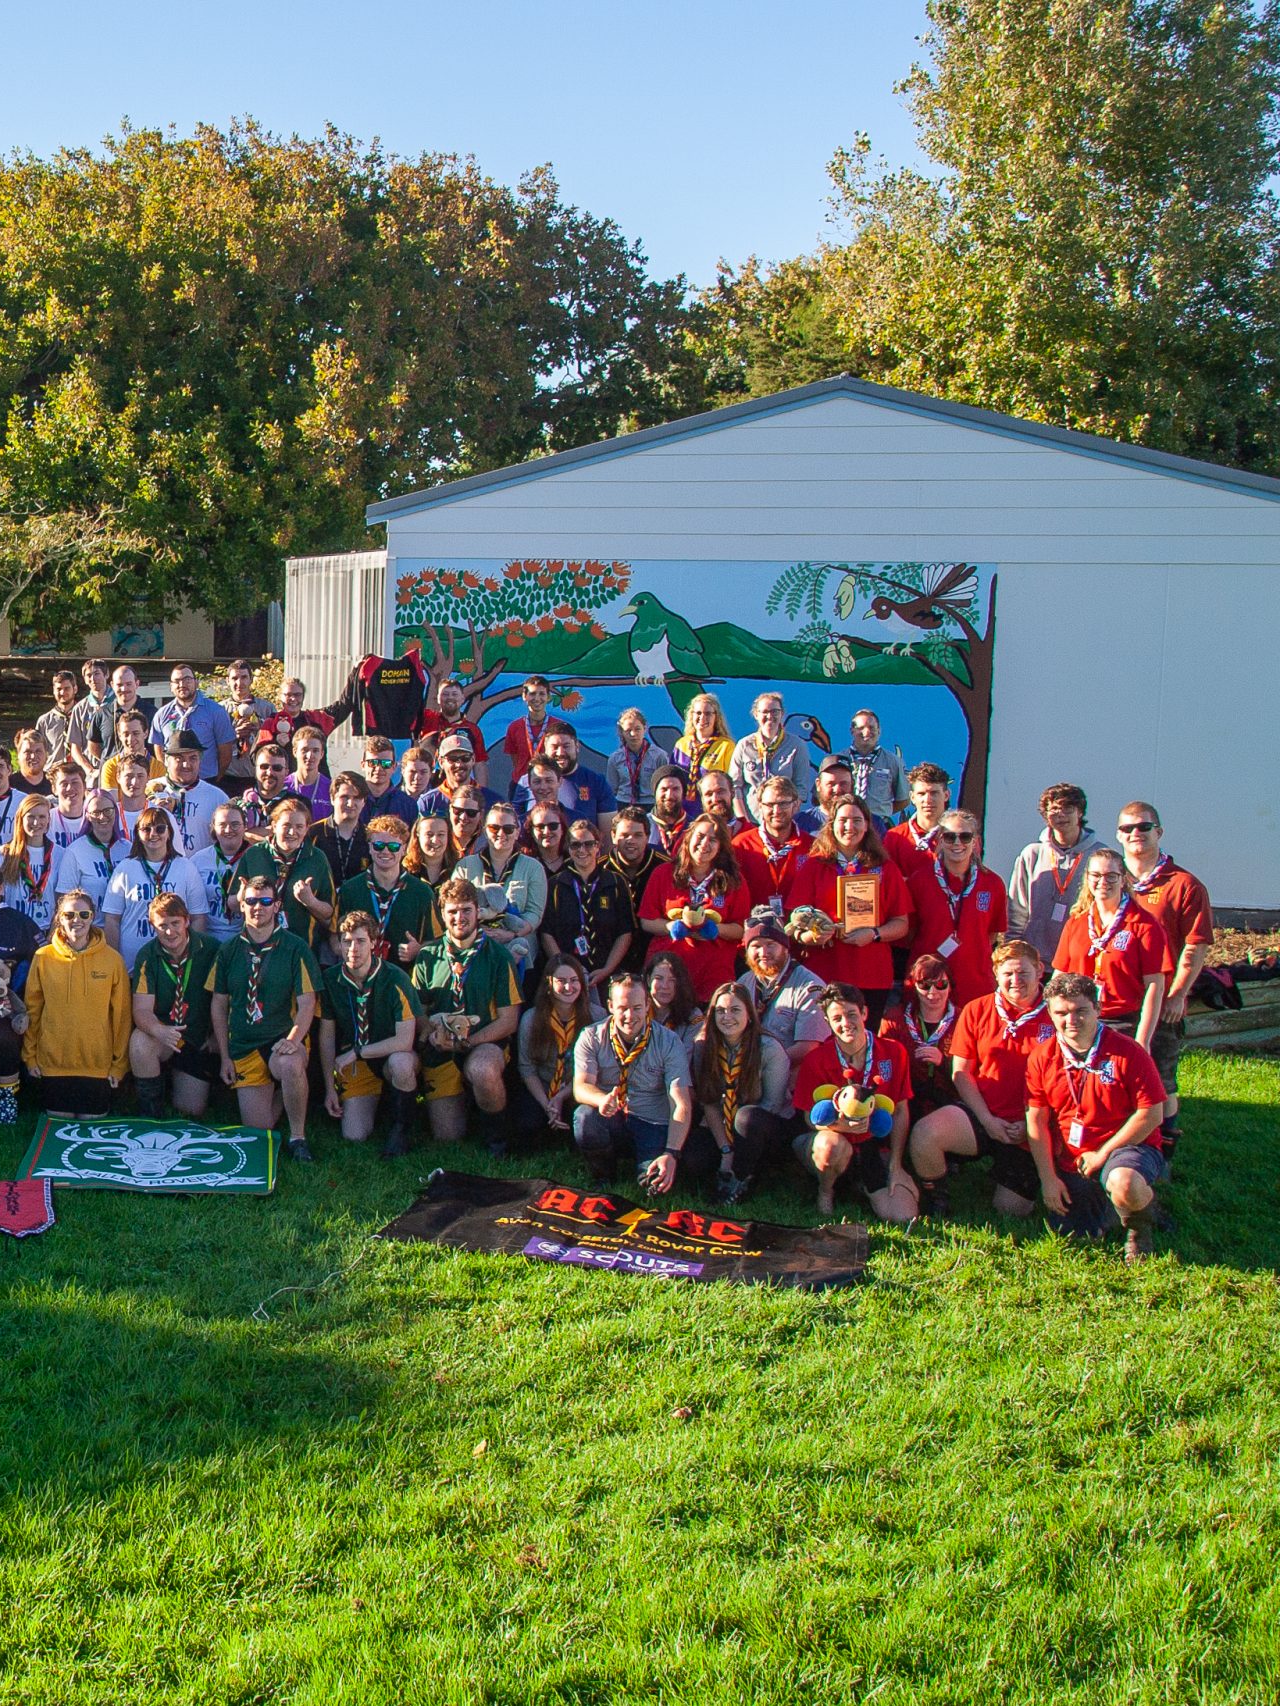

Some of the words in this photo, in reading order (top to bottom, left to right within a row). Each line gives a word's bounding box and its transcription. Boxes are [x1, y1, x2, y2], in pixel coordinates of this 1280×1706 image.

[149, 1173, 220, 1185] ROVERS
[645, 1235, 705, 1255] Rover
[577, 1249, 690, 1274] SCOUTS
